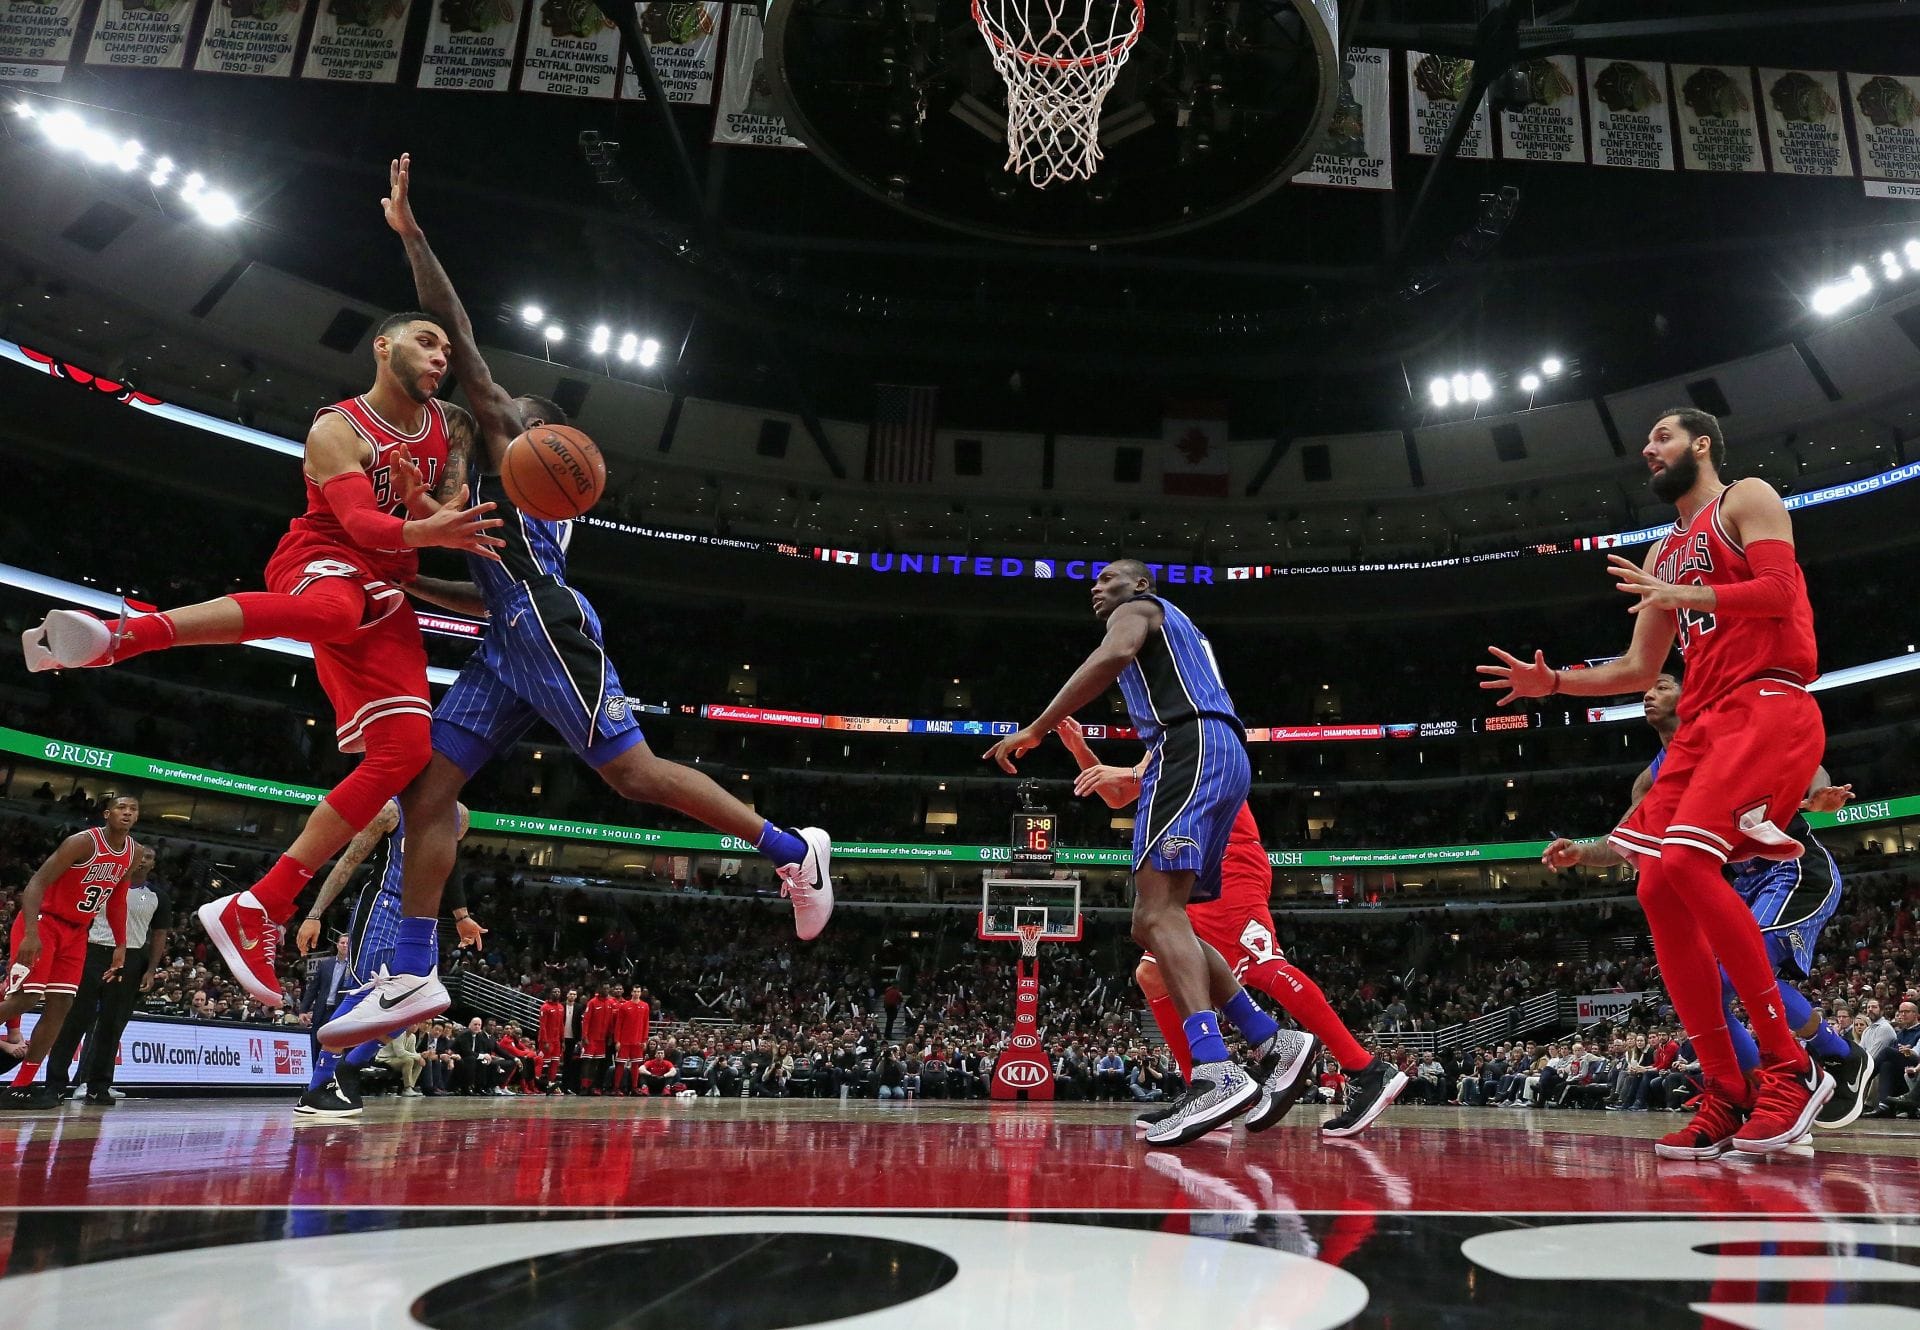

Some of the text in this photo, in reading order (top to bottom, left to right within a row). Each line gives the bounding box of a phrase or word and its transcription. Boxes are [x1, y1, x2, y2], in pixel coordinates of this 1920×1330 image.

[9, 3, 58, 15] CHICAGO
[121, 11, 169, 22] CHICAGO
[25, 26, 72, 37] DIVISION
[104, 21, 181, 33] BLACKHAWKS
[230, 19, 279, 32] CHICAGO
[94, 30, 184, 44] NORRIS DIVISION
[214, 28, 289, 42] BLACKHAWKS
[337, 26, 384, 39] CHICAGO
[204, 38, 292, 53] NORRIS DIVISION
[320, 35, 393, 48] BLACKHAWKS
[449, 35, 495, 46] CHICAGO
[551, 38, 597, 51] CHICAGO
[104, 42, 169, 54] CHAMPIONS
[311, 45, 398, 60] NORRIS DIVISION
[433, 45, 506, 57] BLACKHAWKS
[650, 46, 695, 57] CHICAGO
[213, 50, 277, 63] CHAMPIONS
[423, 54, 512, 68] CENTRAL DIVISION
[535, 47, 608, 63] BLACKHAWKS
[321, 57, 384, 70] CHAMPIONS
[525, 58, 616, 75] CENTRAL DIVISION
[435, 66, 496, 78] CHAMPIONS
[538, 71, 600, 85] CHAMPIONS
[673, 69, 713, 80] DIVISION
[547, 83, 589, 95] 2012-13
[1523, 107, 1560, 116] HICAGO
[727, 114, 782, 125] STANLEY
[1509, 114, 1573, 126] BLACKHAWKS
[1610, 114, 1650, 124] CHICAGO
[1699, 119, 1739, 128] CHICAGO
[1518, 124, 1566, 134] WESTERN
[1599, 121, 1662, 133] BLACKHAWKS
[1689, 126, 1752, 137] BLACKHAWKS
[1787, 122, 1826, 132] CHICAGO
[1875, 127, 1914, 137] CHICAGO
[751, 135, 782, 145] 1934
[1511, 132, 1574, 143] CONFERENCE
[1608, 131, 1655, 141] WESTERN
[1698, 136, 1749, 145] CAMPBELL
[1777, 129, 1839, 141] BLACKHAWKS
[1516, 141, 1570, 152] CHAMPIONS
[1600, 139, 1663, 151] CONFERENCE
[1693, 144, 1754, 154] CONFERENCE
[1784, 139, 1833, 150] CAMPBELL
[1606, 148, 1660, 159] CHAMPIONS
[1698, 152, 1751, 163] CHAMPIONS
[1780, 146, 1841, 158] CONFERENCE
[1359, 158, 1384, 168] CUP
[1785, 156, 1838, 166] CHAMPIONS
[1328, 174, 1358, 186] 2015
[542, 433, 592, 495] SPALDING
[1804, 478, 1880, 504] LEGENDS
[1881, 463, 1920, 485] LOUN
[588, 517, 617, 529] 50/50
[619, 524, 653, 537] RAFFLE
[655, 530, 697, 542] JACKPOT
[699, 536, 708, 544] IS
[711, 537, 760, 550] CURRENTLY
[1622, 525, 1674, 544] BUD LIGH
[1290, 566, 1330, 574] CHICAGO
[1388, 562, 1419, 570] RAFFLE
[1421, 558, 1460, 569] JACKPOT
[1462, 556, 1470, 564] IS
[1472, 550, 1520, 563] CURRENTLY
[871, 552, 1215, 585] UNITED CETER
[430, 619, 476, 633] EVERYBODY
[680, 704, 695, 714] 1st
[710, 706, 819, 725] Budweiser CHAMPIONS CLUB
[840, 716, 870, 724] TIMEOUTS
[1485, 714, 1528, 724] OFFENSIVE
[926, 721, 953, 732] MAGIC
[999, 724, 1011, 733] 57
[1420, 720, 1457, 730] ORLANDO
[1486, 721, 1529, 731] REBOUNDS
[1087, 727, 1100, 736] 82
[1276, 727, 1378, 738] Budweiser CHAMPIONS CLUB
[1420, 728, 1455, 737] CHICAGO
[61, 745, 113, 768] RUSH
[149, 764, 163, 774] The
[165, 768, 201, 781] preferred
[203, 775, 233, 787] medical
[234, 782, 257, 792] center
[259, 785, 268, 793] of
[269, 787, 283, 796] the
[284, 789, 316, 802] Chicago
[1849, 802, 1890, 820] RUSH
[495, 818, 515, 828] IT'S
[519, 820, 545, 830] HOW
[549, 823, 598, 836] MEDICINE
[602, 829, 641, 840] SHOULD
[1026, 818, 1051, 830] 3:48
[1029, 831, 1046, 850] 16
[911, 848, 936, 857] Chicago
[1268, 853, 1302, 864] RUSH
[1342, 854, 1372, 863] preferred
[1373, 853, 1397, 861] medical
[1439, 850, 1465, 858] Chicago
[1017, 1037, 1033, 1046] KIA
[131, 1041, 241, 1066] CDW.com/adobe
[251, 1065, 263, 1074] Adobe
[1007, 1066, 1040, 1081] KIA
